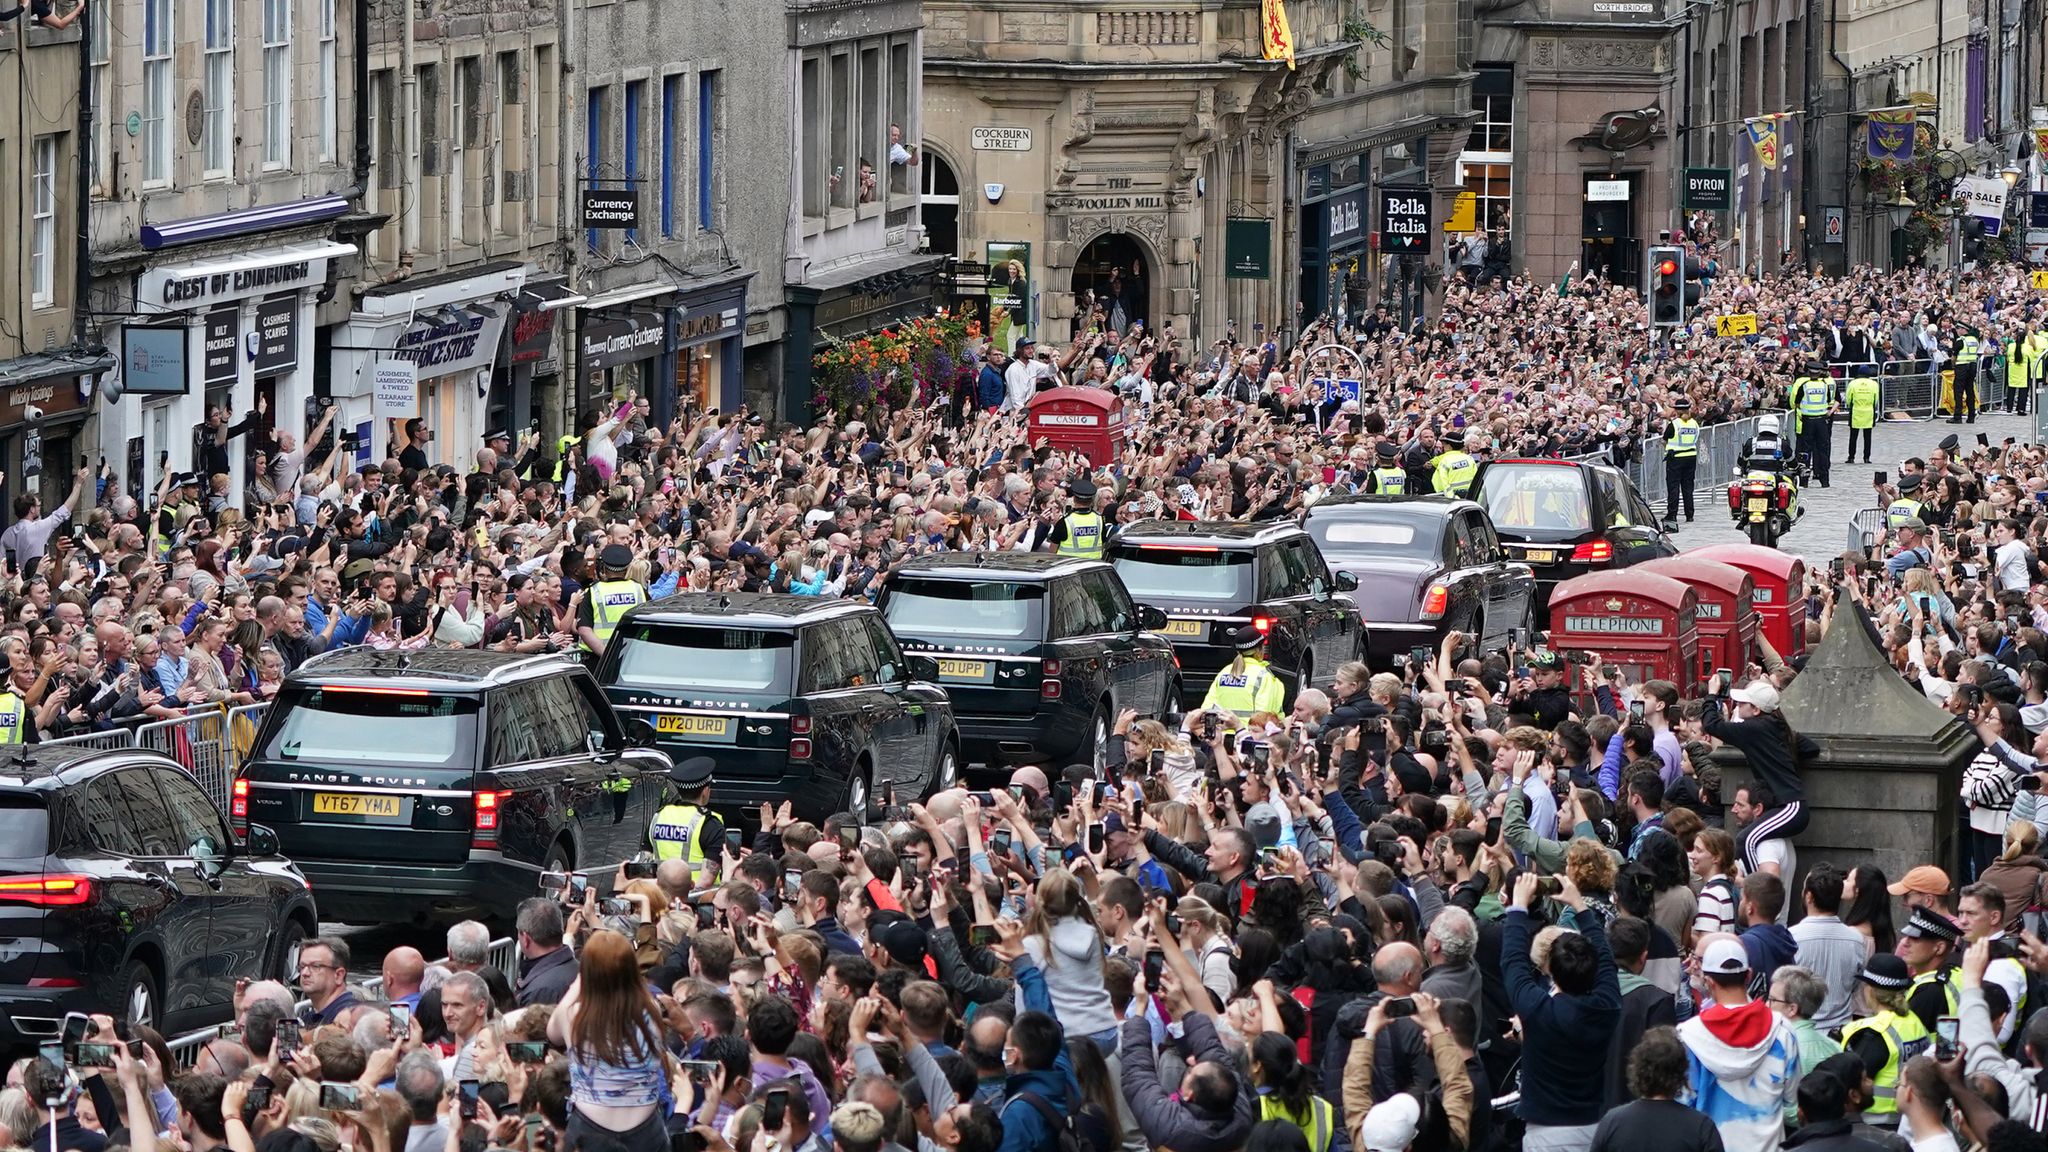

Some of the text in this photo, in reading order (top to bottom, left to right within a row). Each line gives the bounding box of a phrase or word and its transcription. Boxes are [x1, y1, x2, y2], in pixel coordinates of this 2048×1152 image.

[974, 128, 1030, 139] COCKBURN
[984, 138, 1019, 148] STREET
[1107, 178, 1132, 189] THE
[1689, 178, 1725, 191] BYRON
[1075, 197, 1163, 209] WOOLLEN MILL
[1955, 190, 2002, 204] FOR SALE
[587, 198, 633, 211] Currency
[1387, 198, 1426, 215] Bella
[585, 210, 634, 221] Exchange
[1330, 200, 1359, 237] Bella Italia
[1386, 217, 1427, 234] Italia
[163, 261, 309, 304] CREST OF EDINBURGH
[992, 297, 1022, 305] Barbour
[262, 312, 291, 327] CASHMERE
[214, 325, 228, 337] KILT
[264, 325, 289, 340] SCARVES
[206, 336, 236, 352] PACKAGES
[607, 335, 635, 353] Currency
[634, 326, 664, 346] Exchange
[443, 333, 480, 363] STORE
[375, 377, 414, 385] LAMBSWOOL
[1056, 415, 1080, 424] CASH
[27, 428, 39, 438] THE
[1756, 441, 1776, 449] POLICE
[1075, 527, 1097, 536] POLICE
[606, 593, 635, 604] POLICE
[1175, 622, 1196, 633] ALO
[1570, 618, 1660, 632] TELEPHONE
[940, 661, 982, 674] 20 UPP
[1221, 674, 1246, 687] POLICE
[629, 697, 750, 709] RANGE ROVER
[659, 716, 723, 732] OY20 URD
[289, 773, 426, 785] RANGE ROVER
[321, 795, 393, 814] YT67 YMA
[654, 825, 688, 841] POLICE
